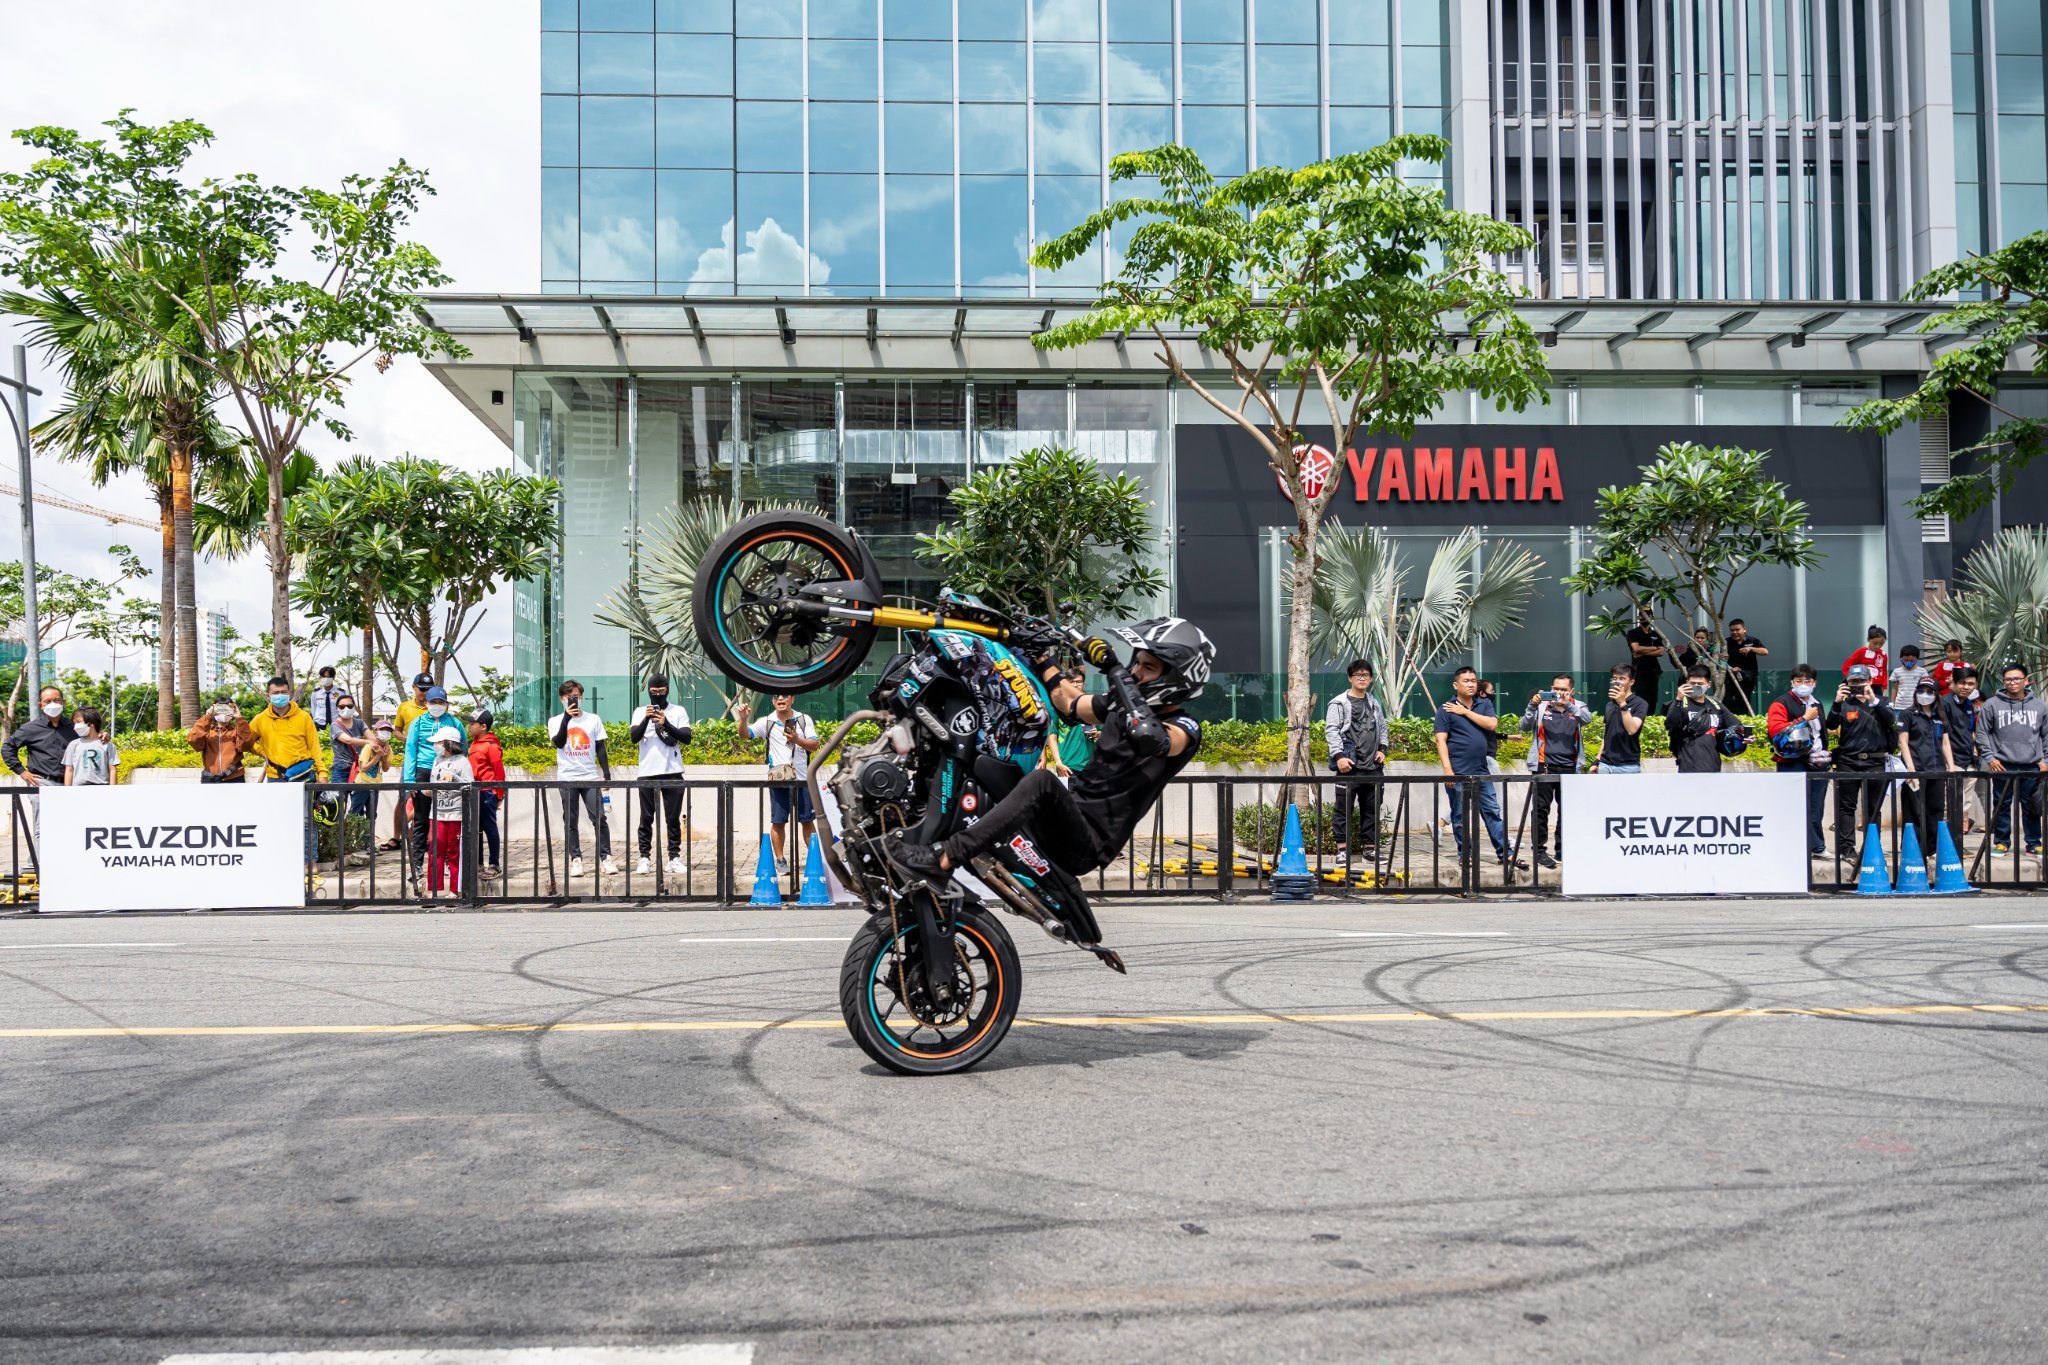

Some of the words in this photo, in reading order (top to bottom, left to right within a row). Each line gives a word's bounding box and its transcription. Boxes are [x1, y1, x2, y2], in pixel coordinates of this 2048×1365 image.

[1346, 448, 1564, 502] YAMAHA
[994, 659, 1039, 719] STUNT
[85, 825, 258, 850] REVZONE
[1605, 815, 1764, 839] REVZONE
[101, 854, 176, 867] YAMAHA
[181, 854, 243, 867] MOTOR
[1619, 844, 1689, 856] YAMAHA
[1693, 844, 1751, 856] MOTOR
